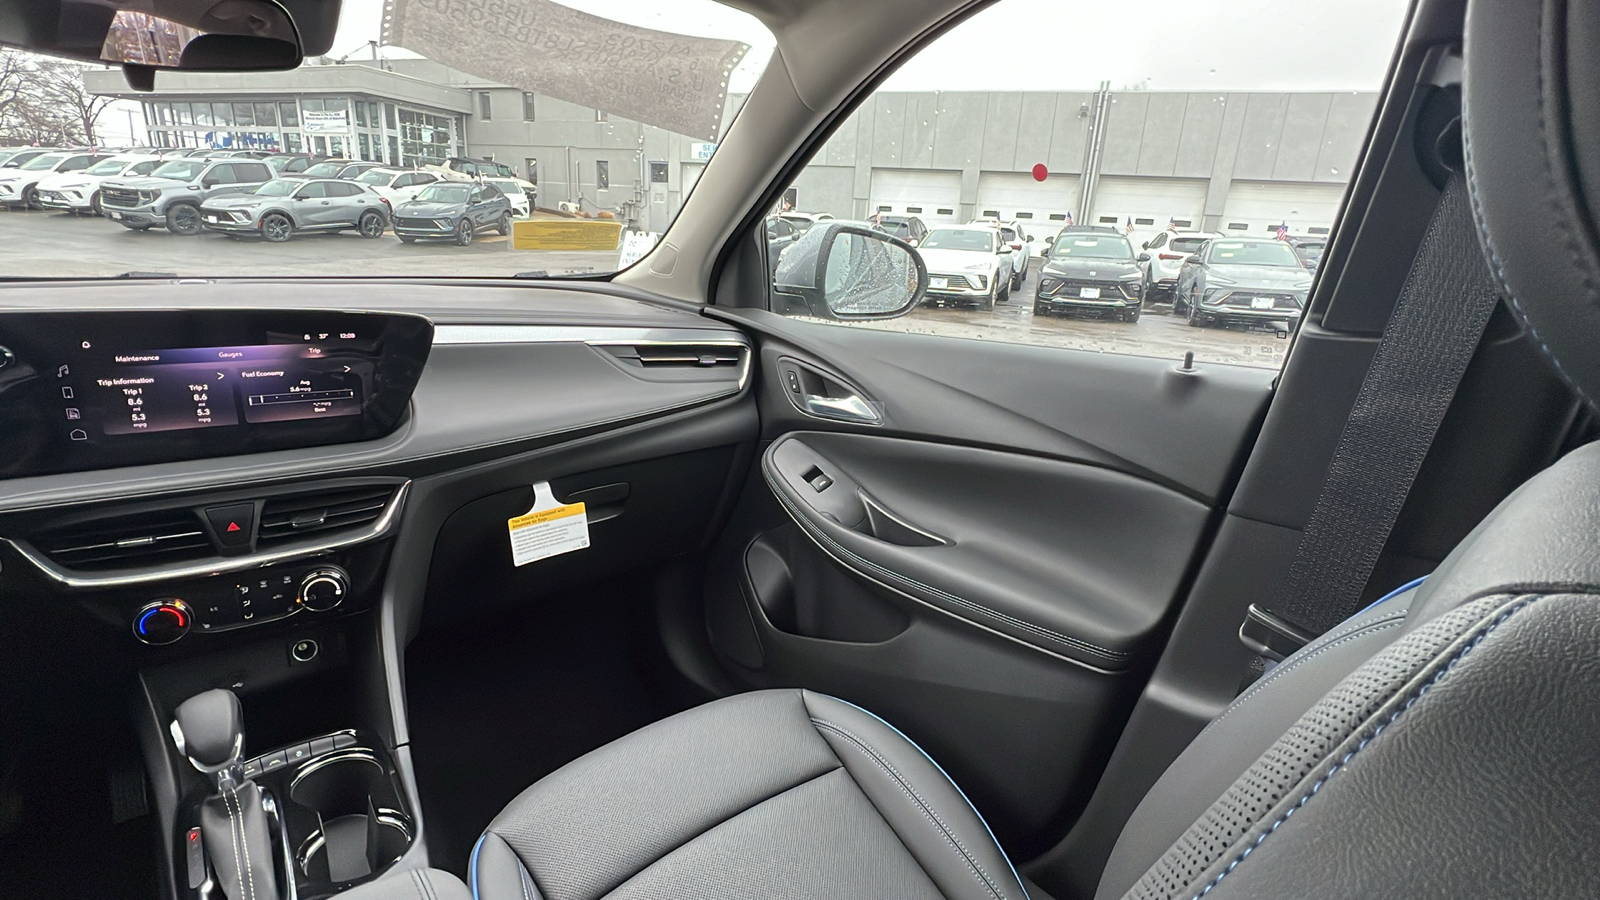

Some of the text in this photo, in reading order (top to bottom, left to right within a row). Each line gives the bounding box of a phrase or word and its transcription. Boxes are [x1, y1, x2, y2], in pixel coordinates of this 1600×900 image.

[115, 355, 160, 363] Maintenance
[218, 351, 243, 359] Gauges
[256, 370, 284, 378] Economy
[97, 377, 155, 387] Trip Information
[122, 388, 138, 396] Trip
[188, 384, 203, 392] Trip
[196, 408, 211, 416] 5.3
[131, 413, 146, 421] 5.3
